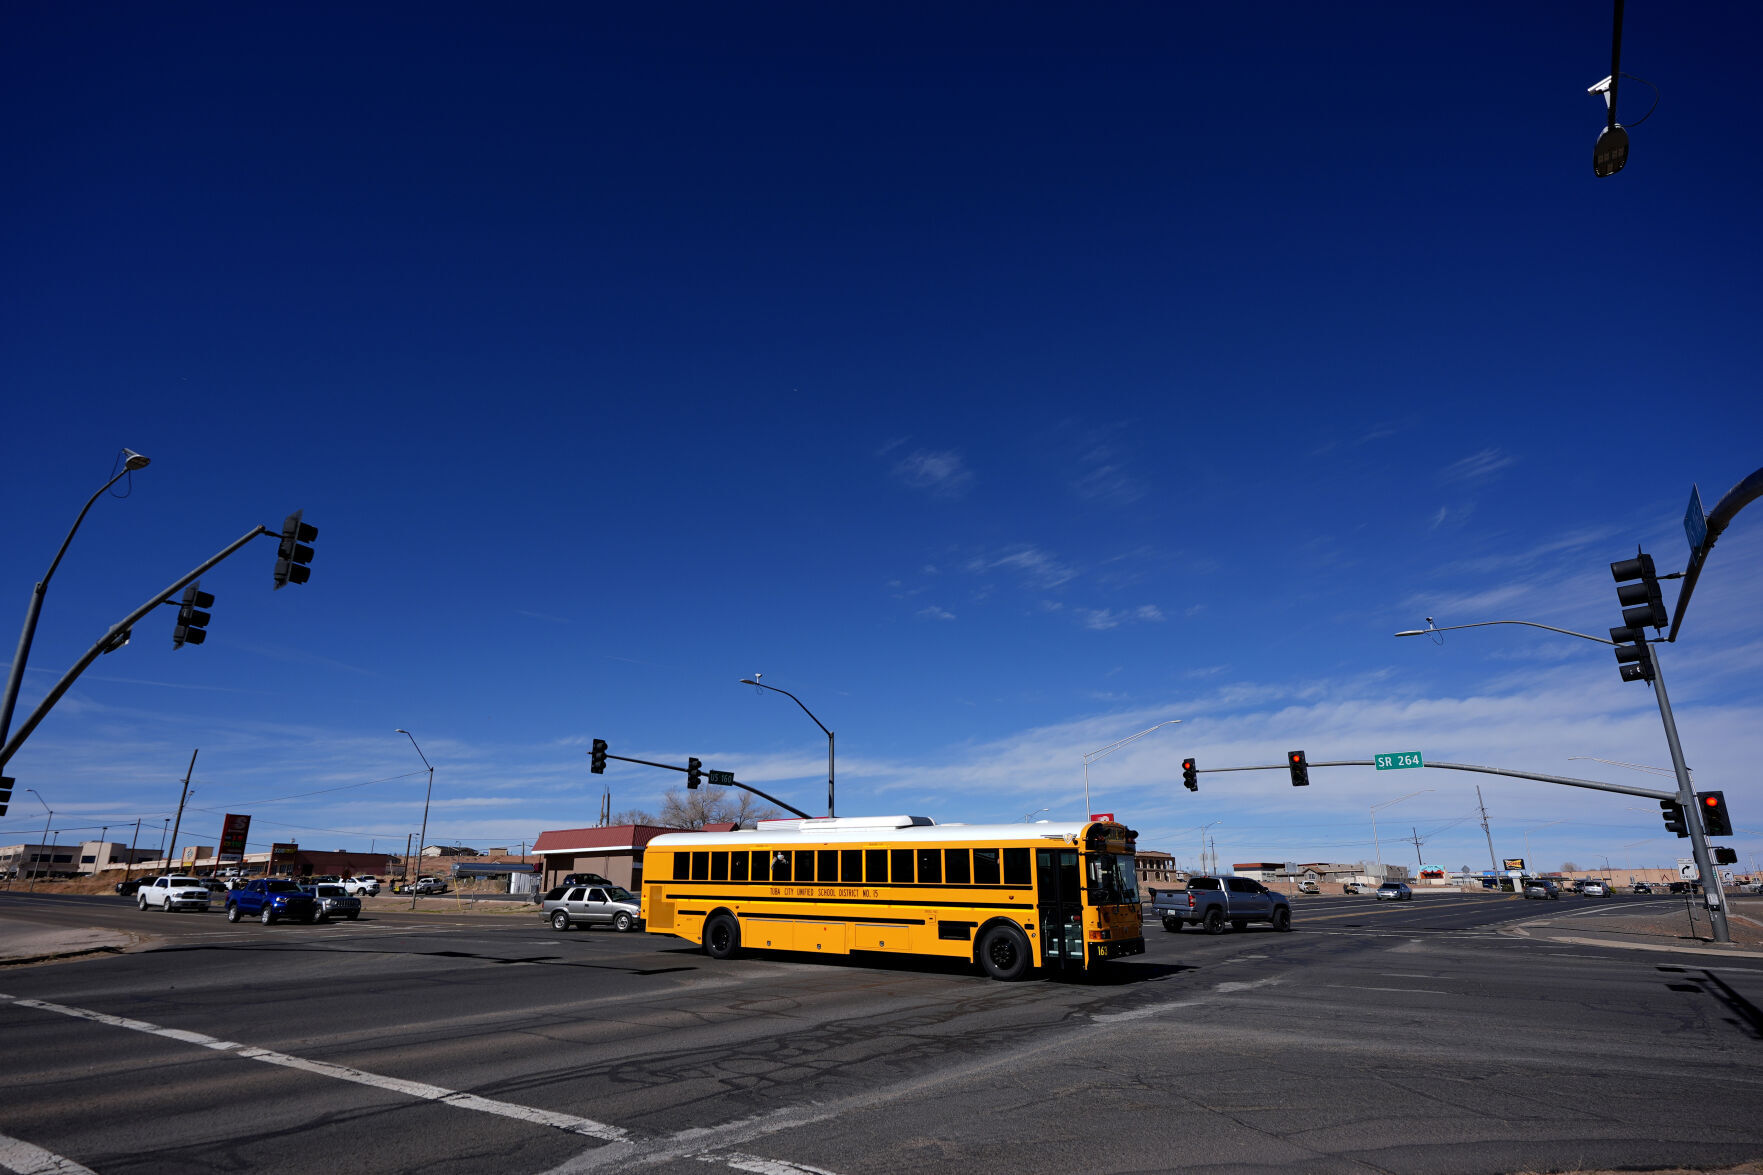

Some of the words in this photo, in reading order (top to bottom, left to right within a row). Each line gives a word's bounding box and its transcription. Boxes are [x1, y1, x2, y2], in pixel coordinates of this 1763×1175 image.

[1378, 757, 1392, 767] SR
[1397, 755, 1420, 766] 264
[711, 774, 719, 782] US
[721, 774, 732, 784] 160
[770, 887, 781, 896] TUBA
[784, 887, 794, 896] CITY
[796, 888, 814, 896] UNIFIED
[818, 888, 836, 897] SCHOOL
[839, 888, 859, 897] DISTRICT
[862, 889, 872, 898] NO.
[873, 889, 879, 898] 15
[1097, 945, 1108, 956] 163
